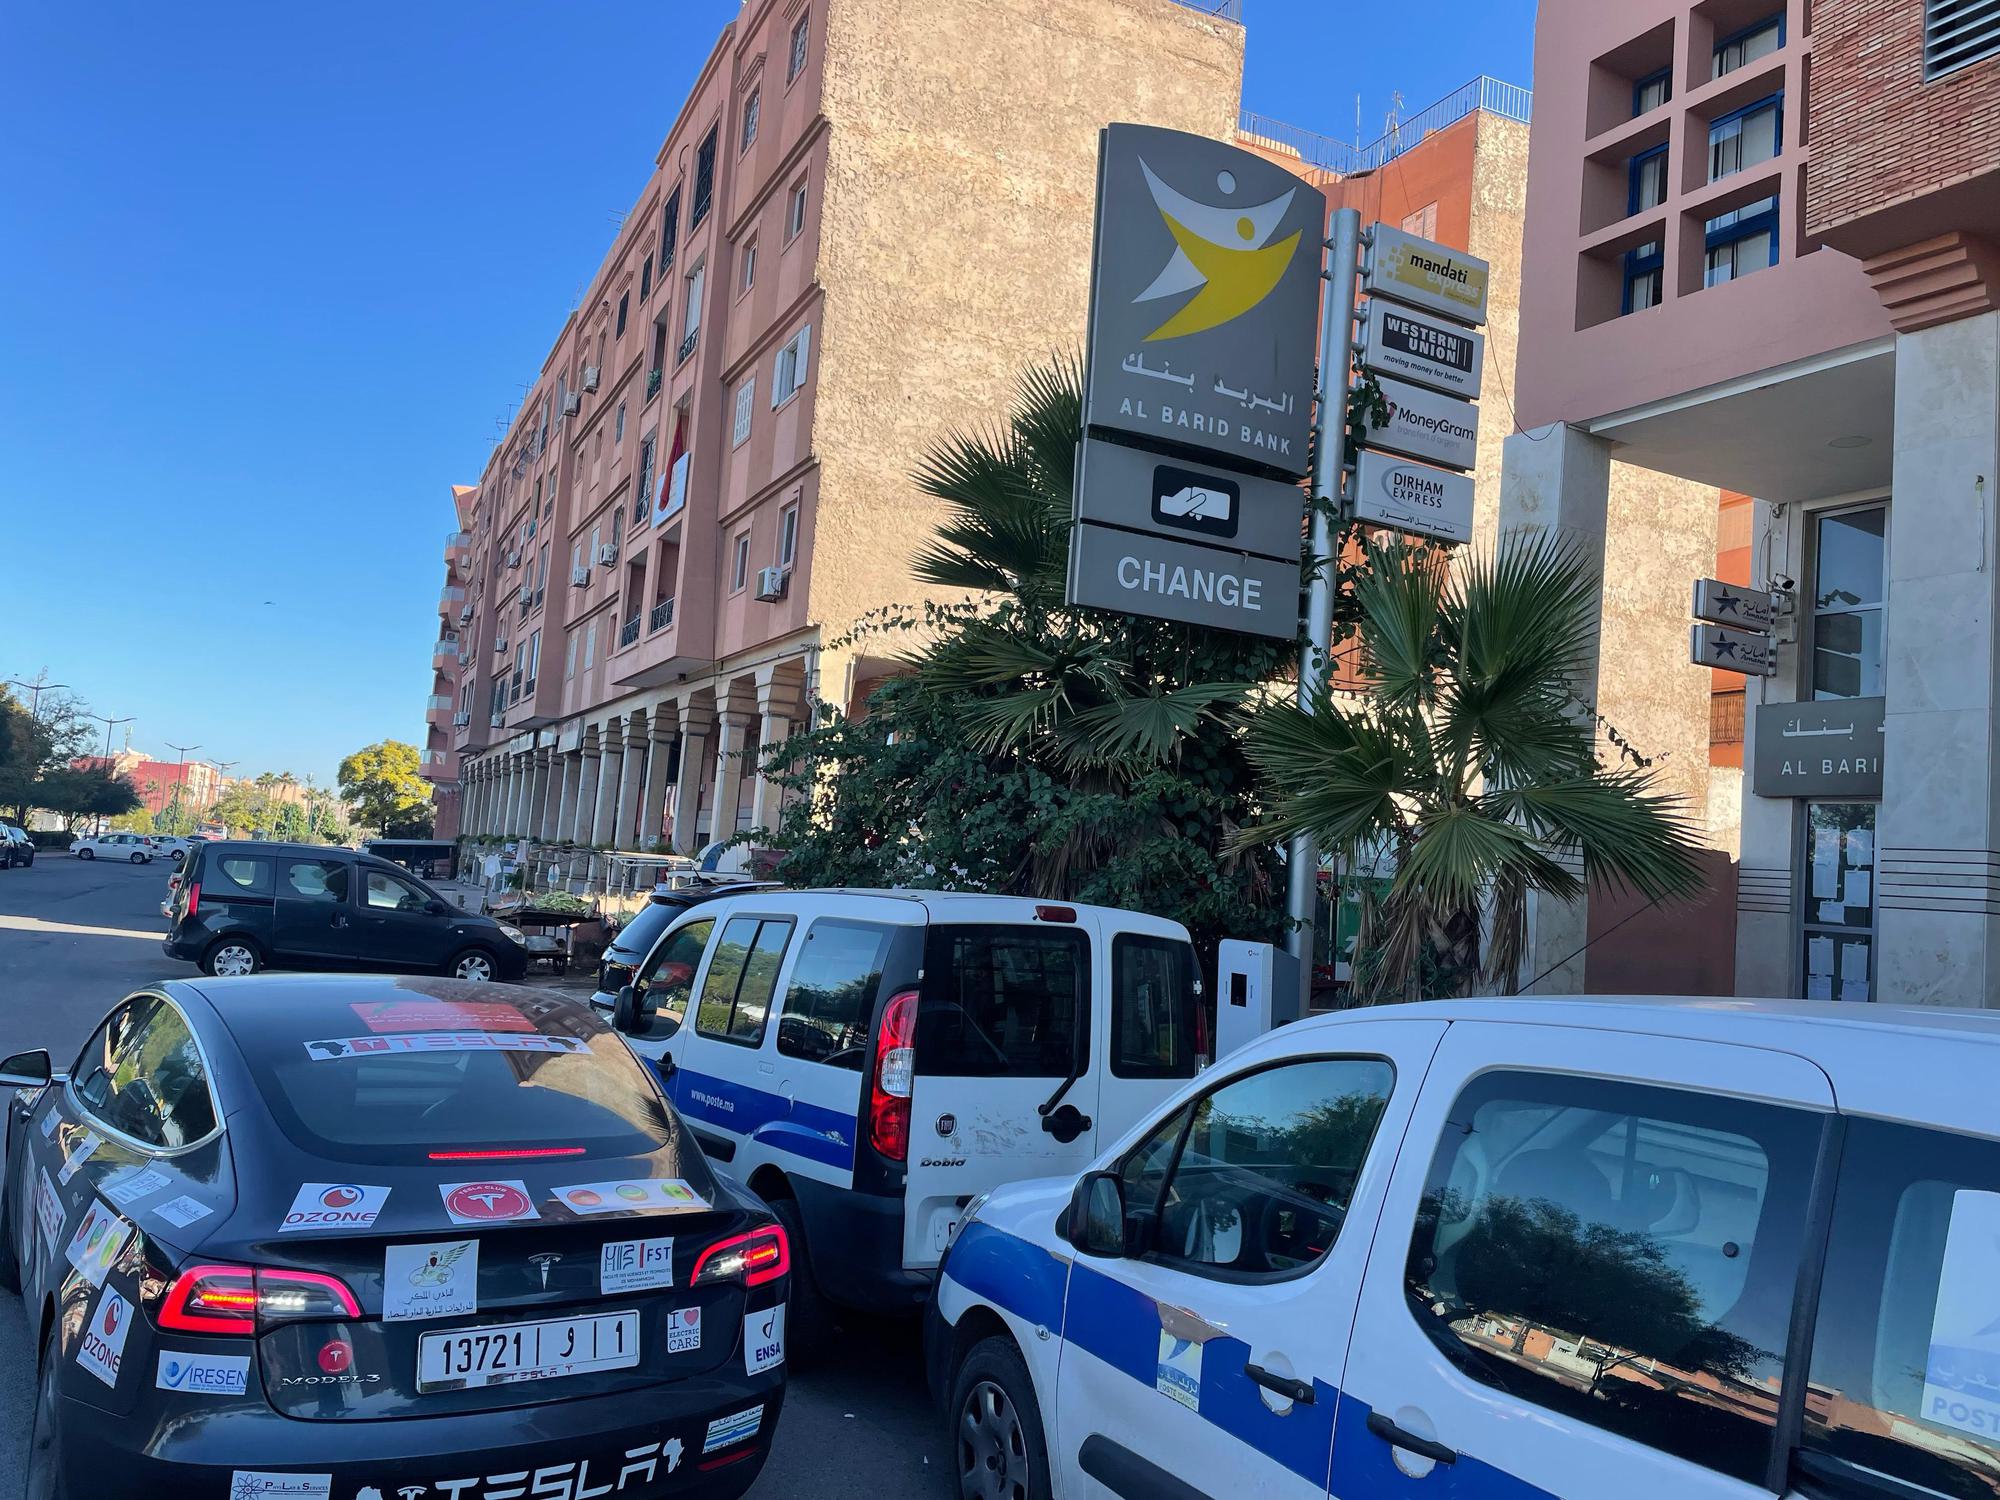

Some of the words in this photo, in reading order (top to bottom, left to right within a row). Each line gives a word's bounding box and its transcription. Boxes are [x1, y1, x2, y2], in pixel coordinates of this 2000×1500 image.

[1410, 254, 1468, 284] mandati
[1426, 272, 1479, 298] express
[1387, 317, 1457, 350] WESTERN
[1408, 338, 1457, 363] UNION
[1122, 352, 1195, 393] بنك
[1384, 354, 1410, 368] moving
[1410, 363, 1433, 375] money
[1434, 368, 1444, 378] for
[1444, 371, 1464, 384] better
[1214, 378, 1294, 415] البريد
[1119, 397, 1148, 419] AL
[1161, 405, 1229, 437] BARID
[1240, 425, 1291, 455] BANK
[1394, 472, 1444, 497] DIRHAM
[1393, 487, 1442, 509] EXPRESS
[1117, 556, 1262, 611] CHANGE
[1742, 610, 1769, 621] Amana
[1740, 654, 1766, 665] Amana
[1783, 718, 1854, 741] بنك
[1781, 760, 1807, 775] AL
[691, 1089, 735, 1113] www.poste.ma
[285, 1211, 378, 1224] OZONE
[646, 1246, 671, 1262] FST
[669, 1312, 680, 1330] I
[669, 1327, 700, 1339] ELECTRIC
[83, 1332, 121, 1374] OZONE
[442, 1332, 521, 1374] 13721
[615, 1320, 623, 1353] 1
[668, 1335, 700, 1351] CARS
[755, 1342, 781, 1362] ENSA
[189, 1367, 248, 1386] IRESEN
[435, 1442, 661, 1500] TESLA
